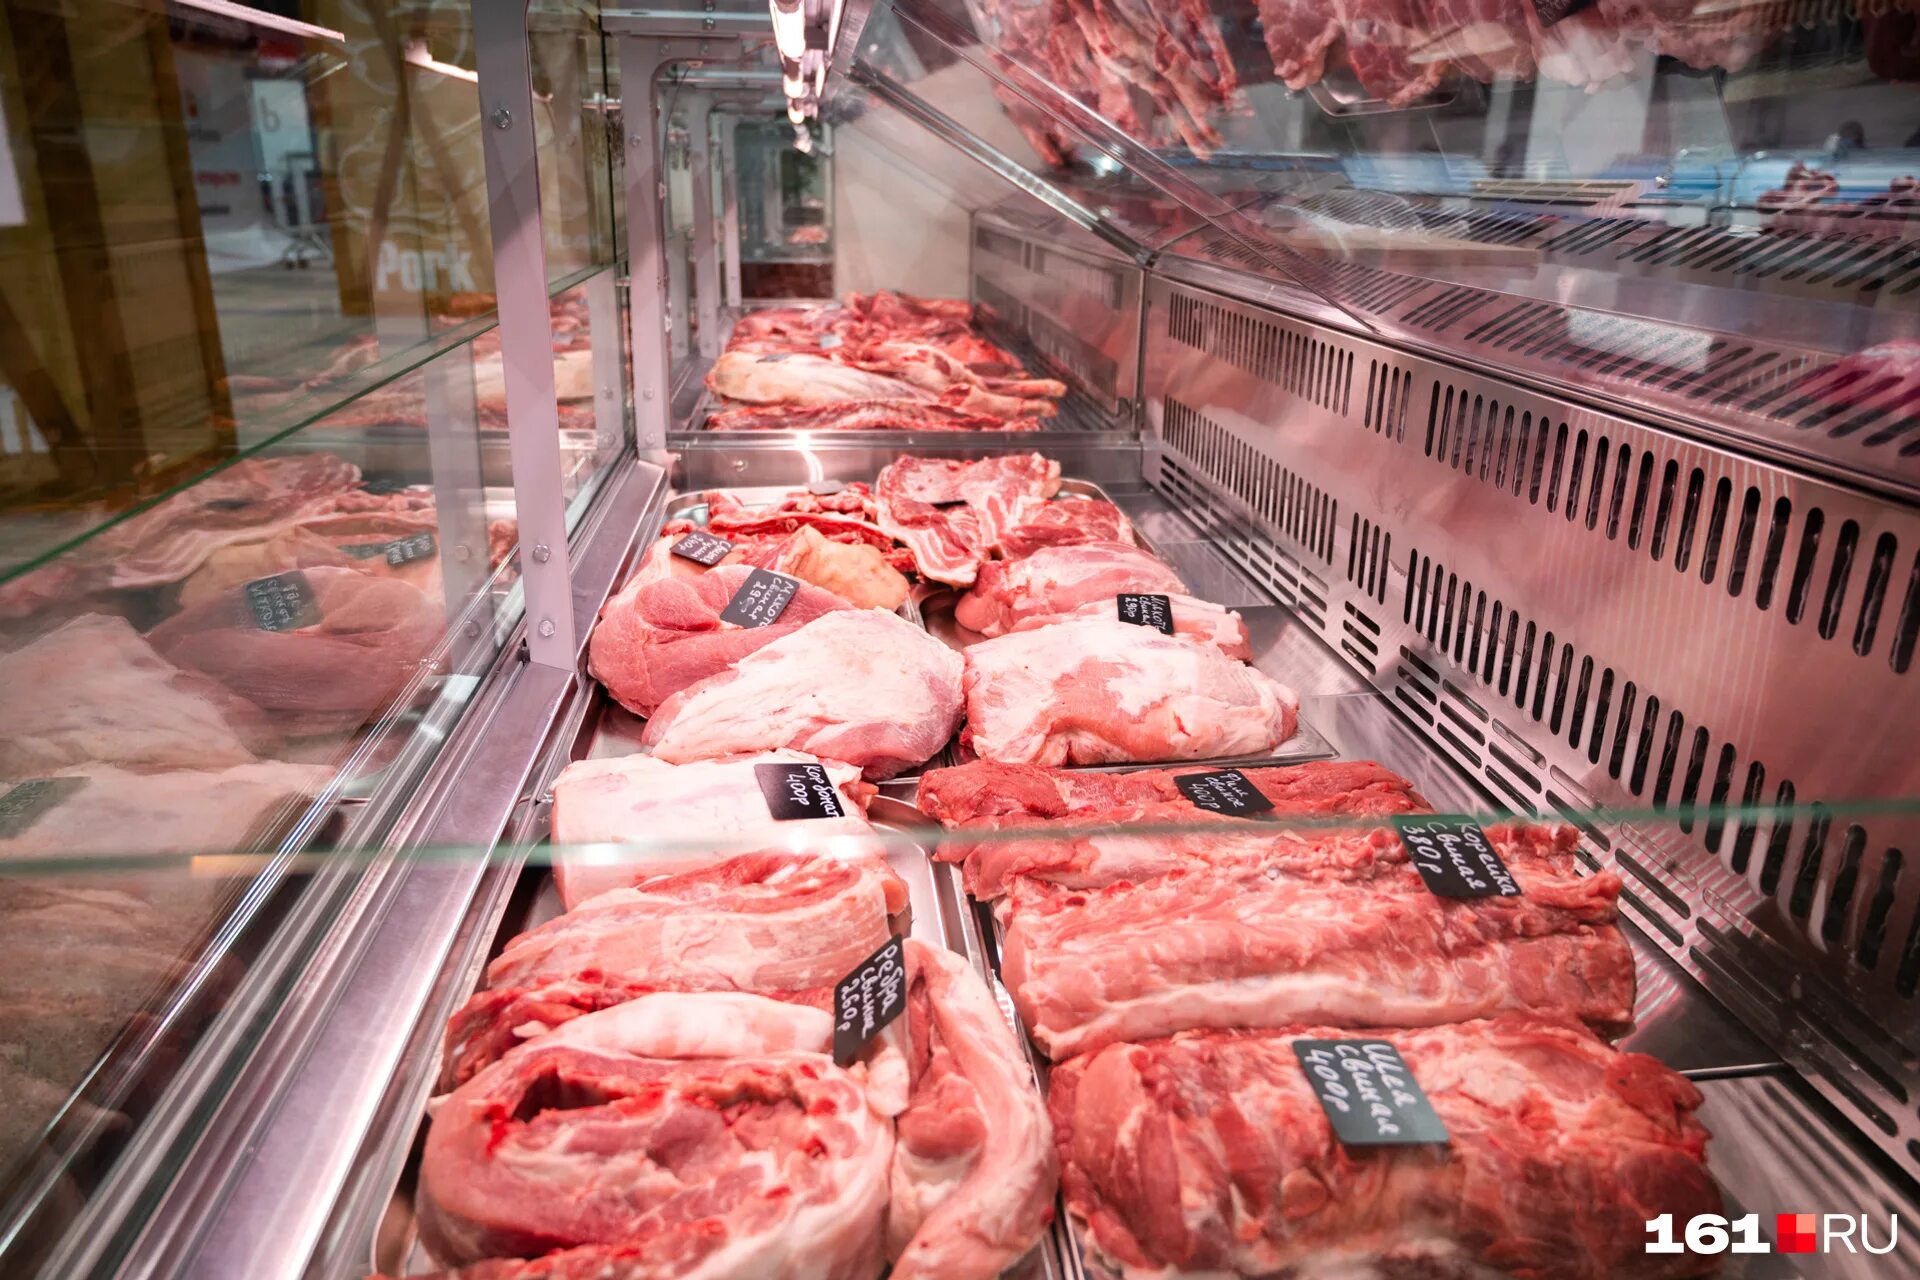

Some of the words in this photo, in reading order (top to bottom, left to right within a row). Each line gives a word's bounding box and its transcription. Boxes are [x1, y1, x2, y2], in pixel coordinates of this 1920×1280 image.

[376, 241, 476, 293] Pork
[786, 774, 810, 805] 400р
[1453, 822, 1516, 896] Корейка
[874, 944, 904, 1017] Ребра
[1304, 1049, 1350, 1112] 400р
[1362, 1044, 1417, 1108] Шея
